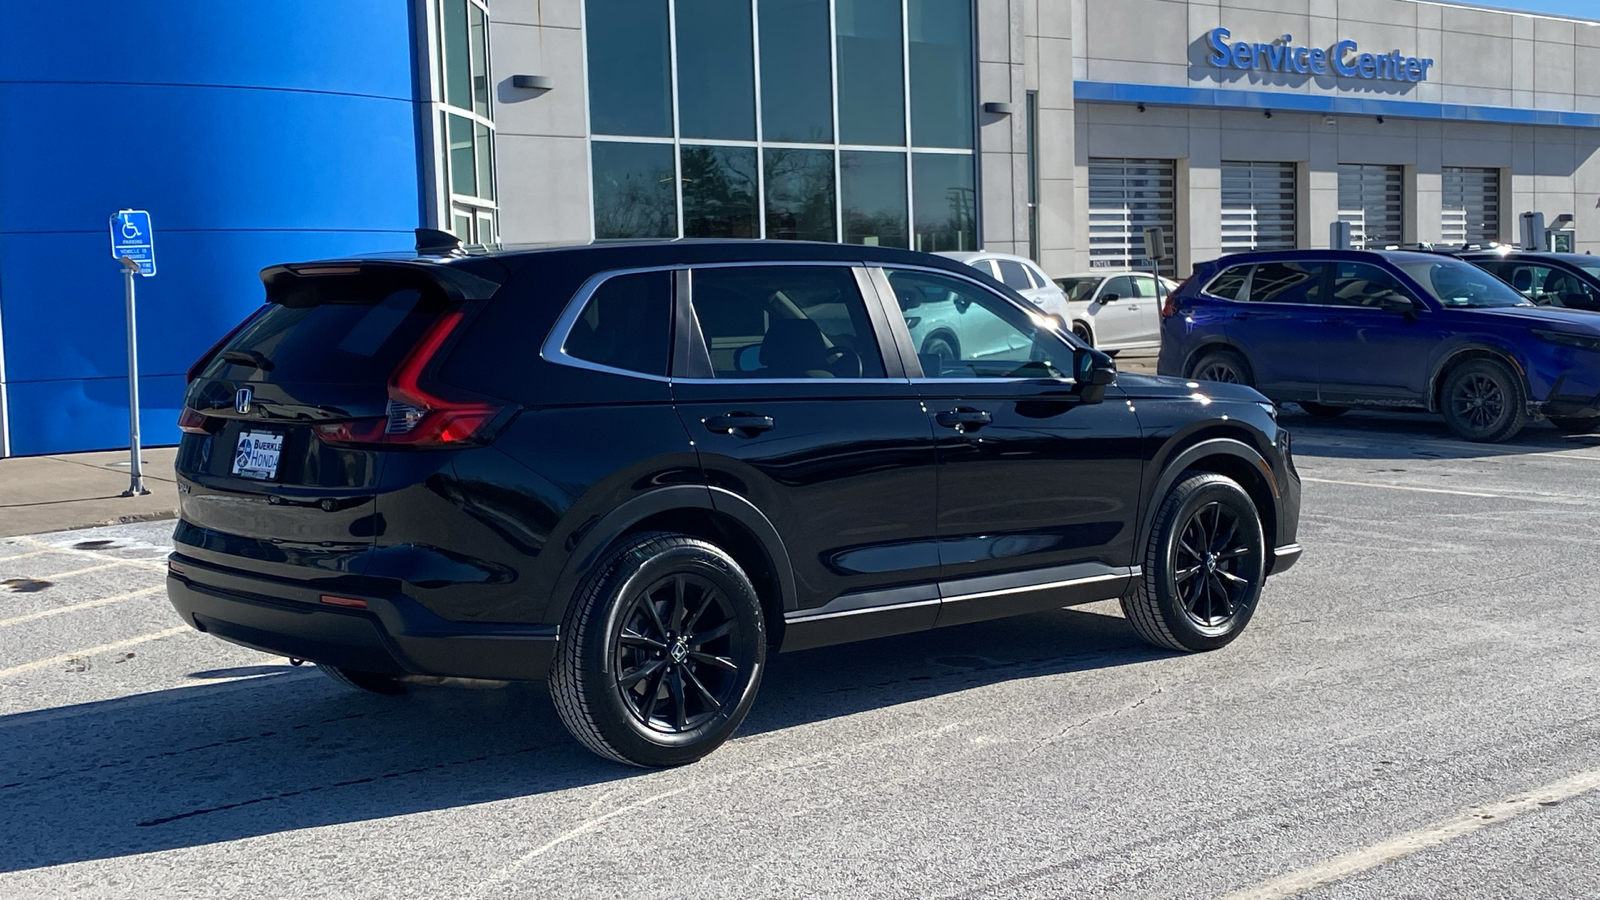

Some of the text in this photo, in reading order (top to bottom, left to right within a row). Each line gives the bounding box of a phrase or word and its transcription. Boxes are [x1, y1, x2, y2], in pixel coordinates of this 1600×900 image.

[1209, 27, 1433, 82] Service Center
[250, 450, 279, 468] HONDA
